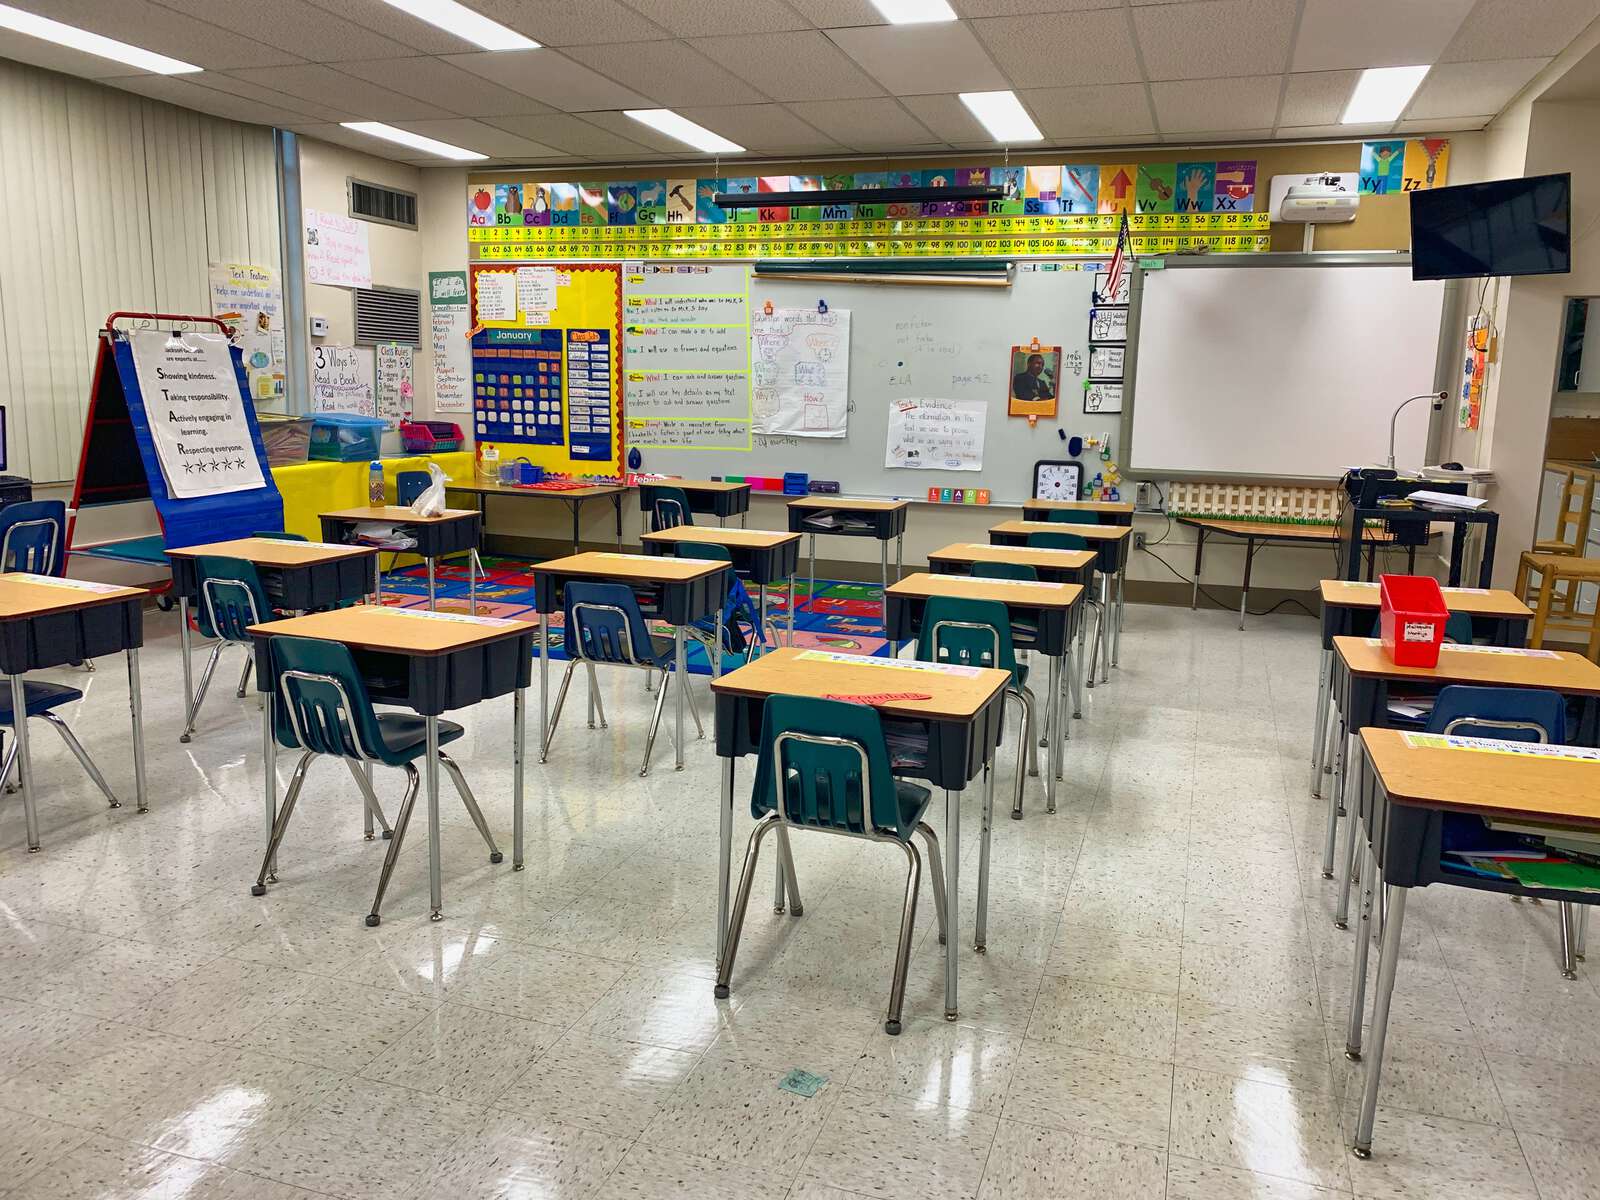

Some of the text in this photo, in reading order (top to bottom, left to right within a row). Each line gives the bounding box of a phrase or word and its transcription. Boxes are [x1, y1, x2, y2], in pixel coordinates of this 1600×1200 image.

[1362, 177, 1421, 193] Yy Zz
[471, 214, 486, 224] Aa
[497, 213, 511, 224] Bb
[525, 213, 541, 224] Cc
[552, 213, 568, 224] Dd
[581, 213, 596, 224] Ee
[610, 213, 620, 224] Ff
[639, 210, 656, 222] Gg
[667, 211, 682, 222] Hh
[729, 207, 738, 221] Jj
[760, 208, 775, 220] Kk
[791, 207, 799, 218] Ll
[822, 205, 848, 217] Mm
[857, 205, 873, 217] Nn
[888, 204, 908, 215] Oo
[922, 202, 938, 215] Pp
[991, 202, 1004, 213] Rr
[1026, 202, 1040, 213] Ss
[1061, 200, 1074, 211] Tt
[1139, 200, 1158, 211] Vv
[1176, 199, 1203, 211] Ww
[1216, 198, 1236, 210] Xx
[761, 224, 770, 232] 25
[850, 222, 859, 230] 32
[863, 221, 872, 229] 33
[877, 221, 886, 229] 34
[904, 221, 913, 229] 36
[945, 220, 955, 228] 39
[1001, 219, 1011, 227] 43
[1044, 218, 1054, 226] 46
[1134, 216, 1144, 224] 52
[1149, 216, 1159, 224] 53
[1164, 216, 1174, 224] 54
[1195, 215, 1206, 223] 56
[1211, 215, 1221, 223] 57
[1227, 215, 1237, 223] 58
[1242, 215, 1253, 223] 59
[1257, 214, 1268, 222] 60
[230, 267, 245, 278] Text
[441, 289, 451, 297] will
[432, 319, 455, 327] February
[433, 333, 447, 341] April
[496, 330, 532, 341] January
[433, 342, 446, 351] May
[315, 347, 325, 370] 3
[327, 348, 347, 371] Ways
[349, 351, 357, 366] to
[434, 359, 446, 368] July
[157, 367, 217, 381] Showing kindness.
[436, 367, 455, 375] August
[314, 368, 330, 384] Read
[339, 373, 358, 386] Book
[437, 375, 465, 383] September
[321, 387, 334, 398] Read
[436, 383, 458, 391] October
[161, 389, 230, 402] Taking responsibility.
[436, 391, 463, 399] November
[322, 399, 335, 411] Read
[437, 400, 465, 408] December
[169, 410, 198, 423] Actively
[198, 414, 225, 422] engaging
[177, 443, 215, 455] Respecting
